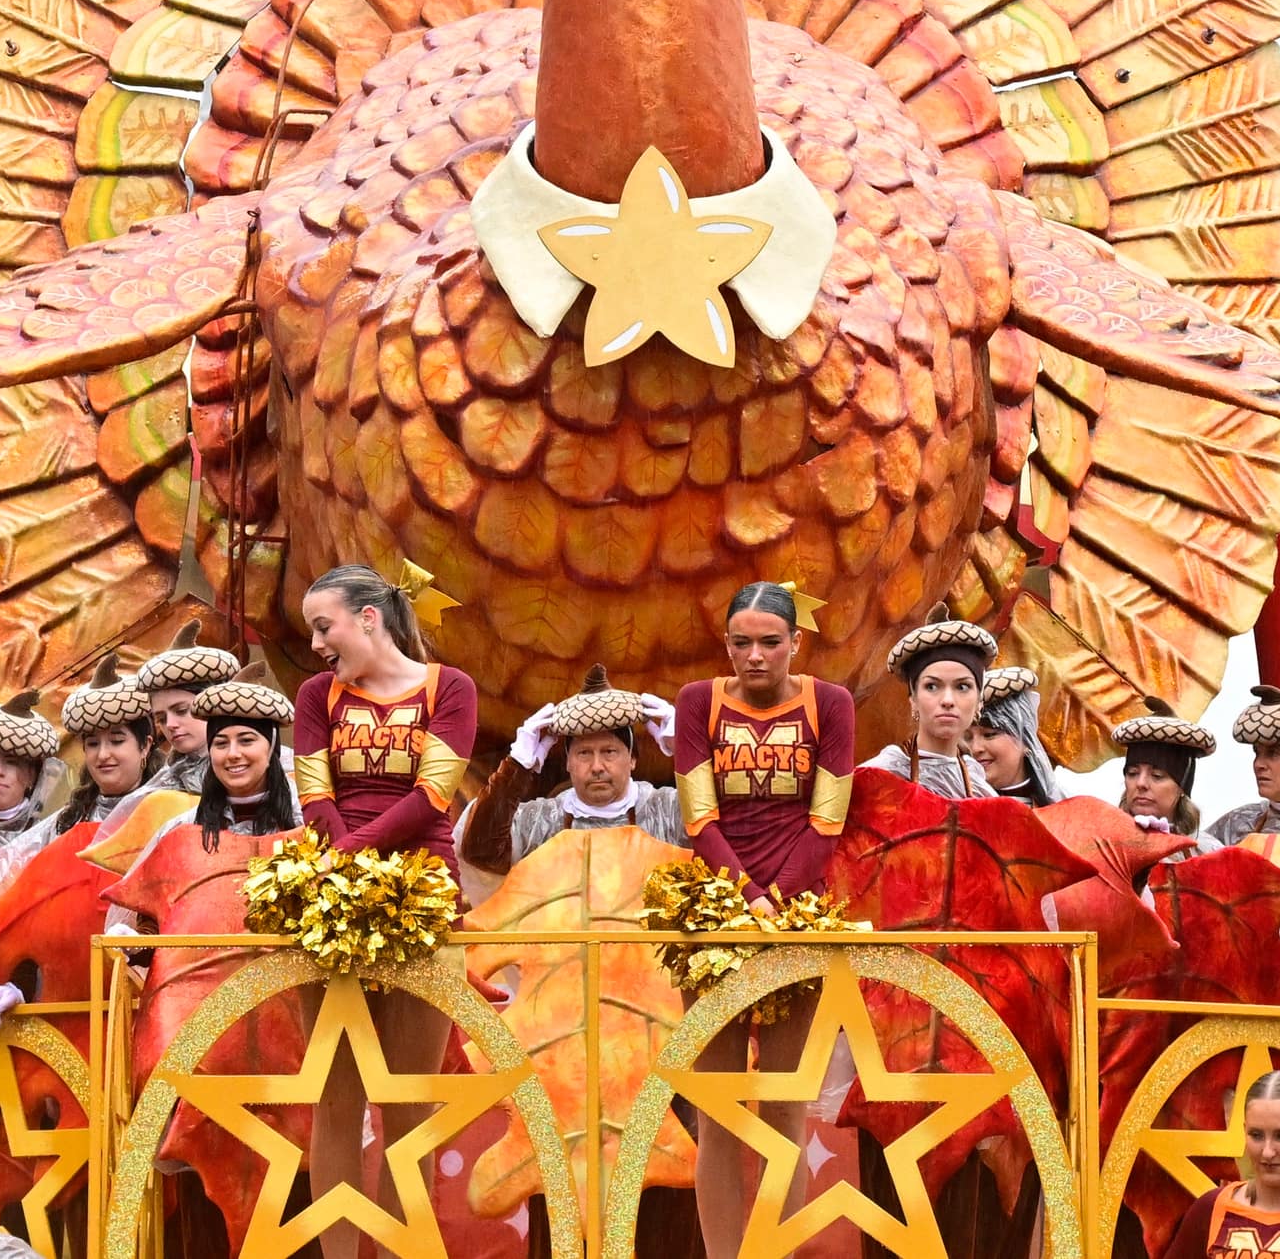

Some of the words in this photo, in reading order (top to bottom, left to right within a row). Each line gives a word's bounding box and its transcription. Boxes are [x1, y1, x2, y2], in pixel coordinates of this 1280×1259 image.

[330, 724, 426, 756] MACYS
[337, 703, 423, 776] M
[713, 745, 811, 774] MACYS
[719, 720, 803, 797] M
